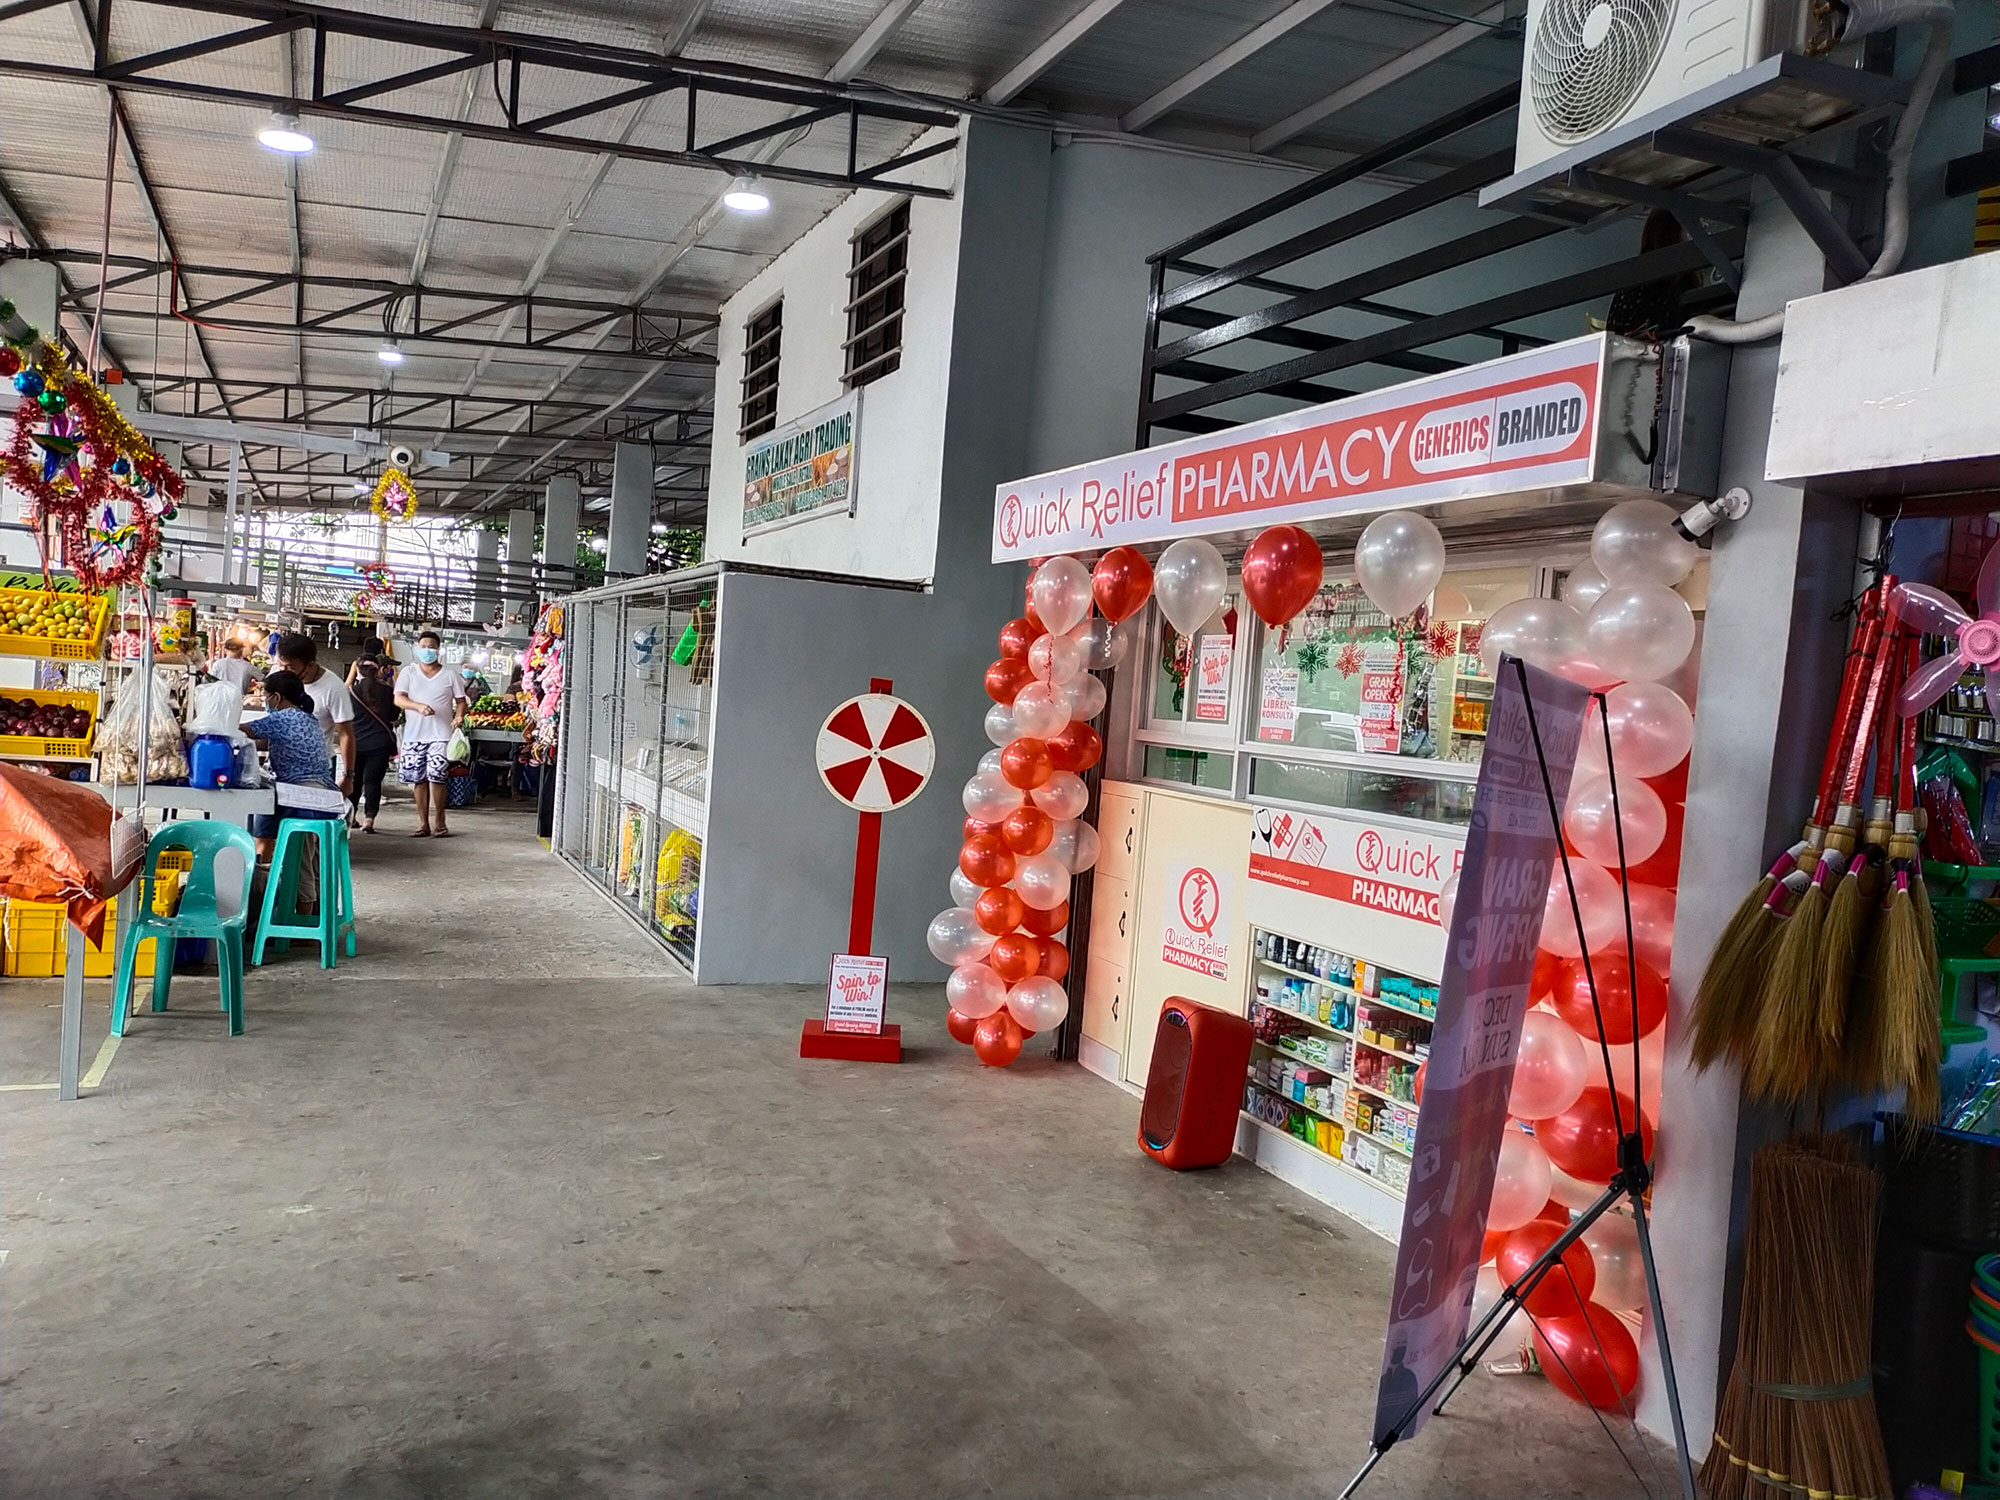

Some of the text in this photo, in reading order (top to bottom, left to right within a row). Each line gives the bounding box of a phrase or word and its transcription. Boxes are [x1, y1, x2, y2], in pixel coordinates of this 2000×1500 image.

[771, 438, 794, 473] LAKAY
[794, 429, 813, 463] AGRI
[815, 411, 852, 456] TRADING
[1414, 414, 1490, 461] GENERICS
[1497, 397, 1582, 447] BRANDED
[1178, 420, 1407, 514] PHARMACY
[999, 493, 1072, 548] Quick
[1369, 613, 1391, 626] YEAR
[1262, 711, 1294, 720] KONSULTA
[1355, 830, 1441, 882] Quick
[1352, 879, 1442, 921] PHARMAC
[1164, 947, 1210, 972] PHARMACY
[1165, 928, 1195, 950] Quick
[836, 971, 881, 993] Spin to
[845, 986, 873, 1003] Win!
